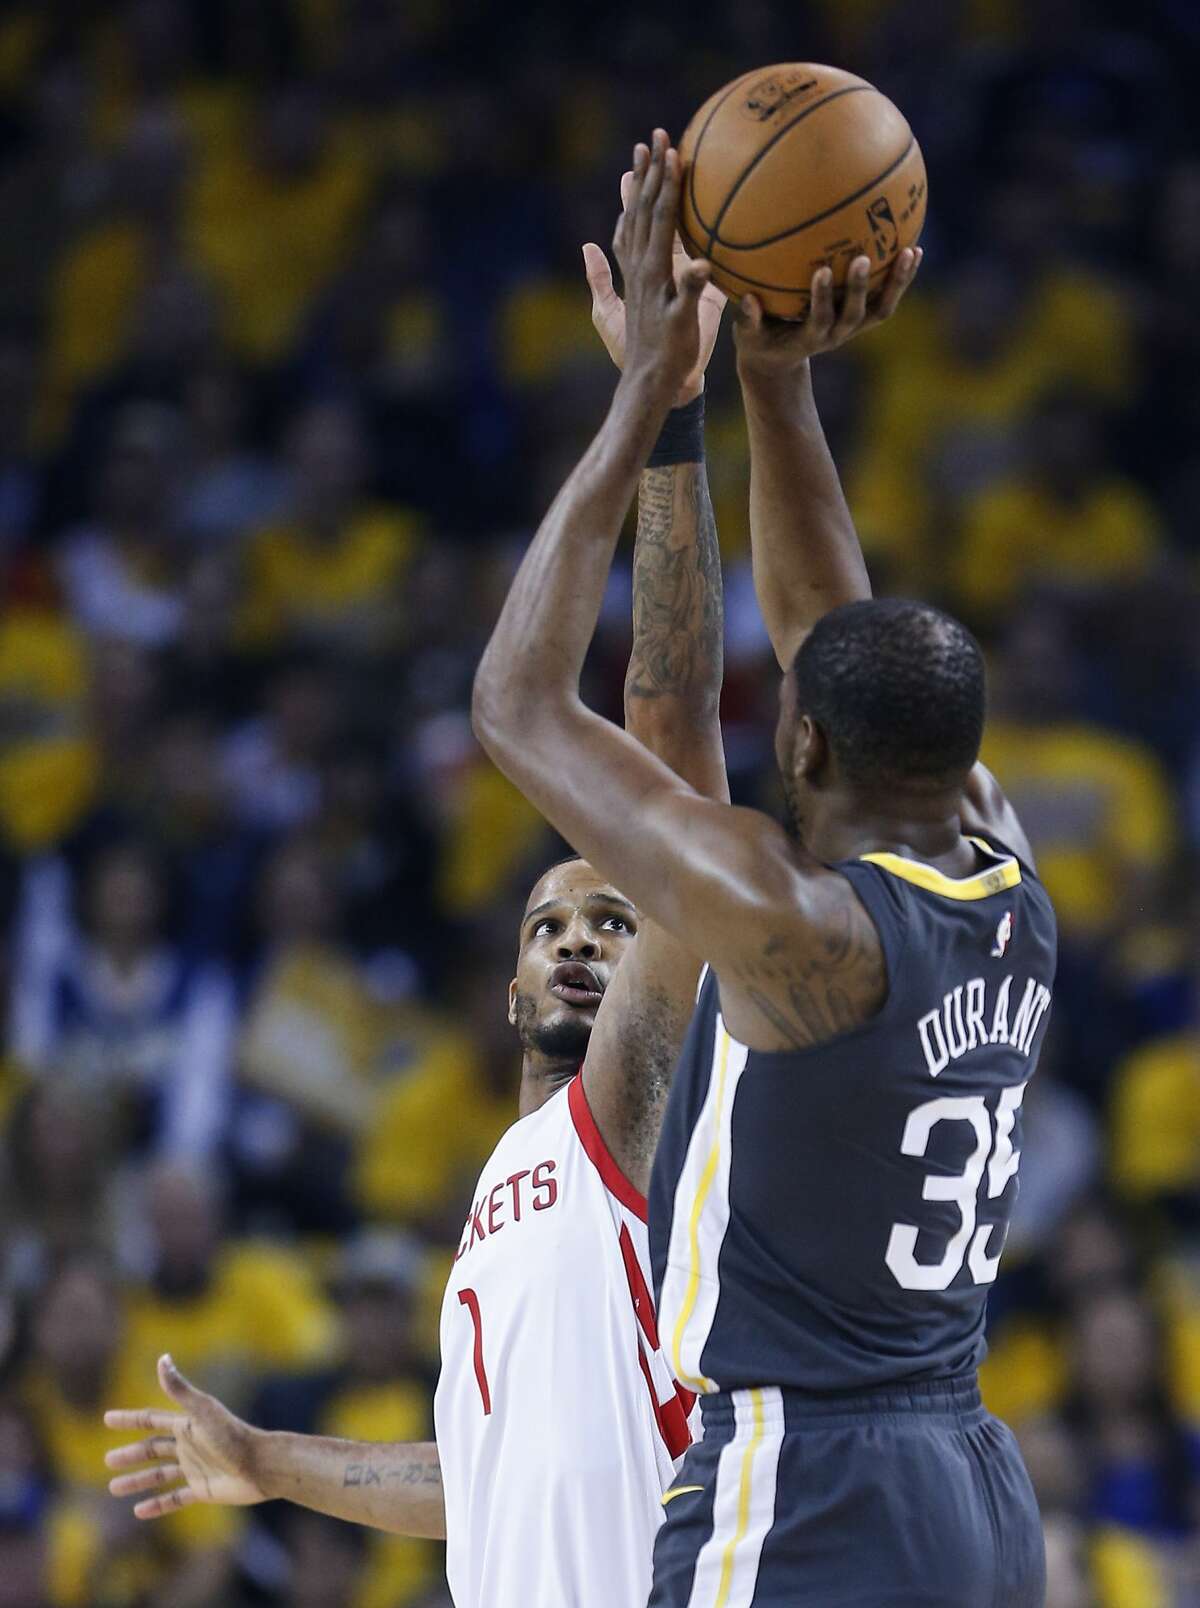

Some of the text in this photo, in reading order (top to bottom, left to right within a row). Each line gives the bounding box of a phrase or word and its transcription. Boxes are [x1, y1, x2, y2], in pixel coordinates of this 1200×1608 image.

[917, 974, 1051, 1078] DURANT
[884, 1081, 1028, 1291] 35
[457, 1287, 492, 1417] 1
